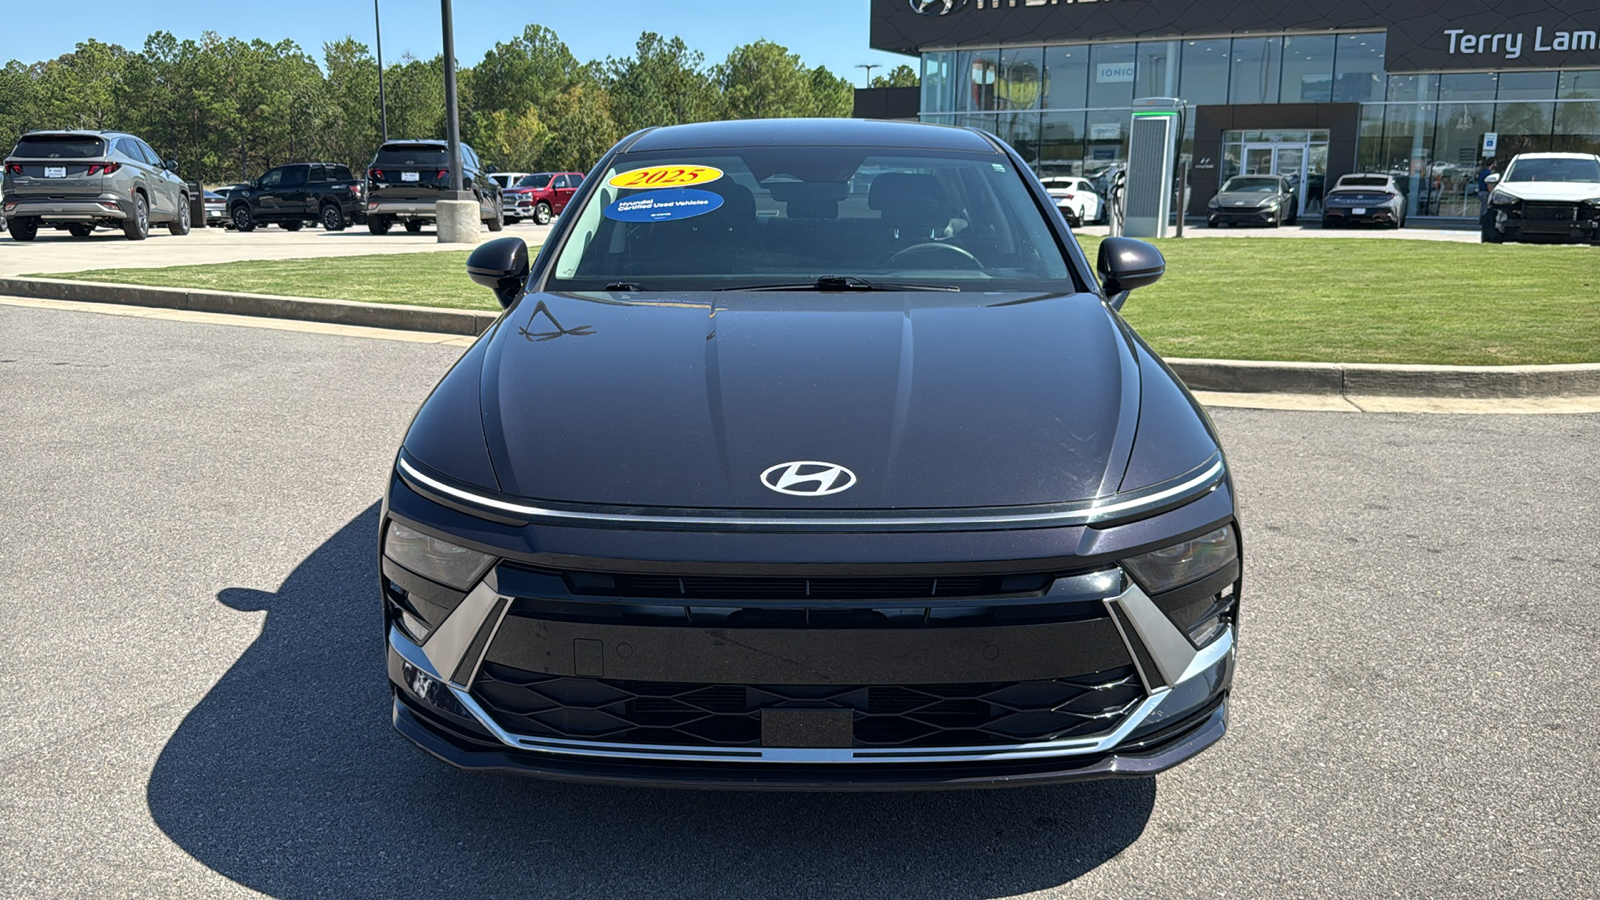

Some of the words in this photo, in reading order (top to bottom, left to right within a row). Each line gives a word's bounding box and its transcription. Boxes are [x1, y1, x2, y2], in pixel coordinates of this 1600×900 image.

[1443, 29, 1523, 59] Terry
[1534, 26, 1600, 52] Lam
[624, 168, 706, 186] 2025
[617, 203, 652, 211] Certified
[619, 199, 654, 207] Hyundai
